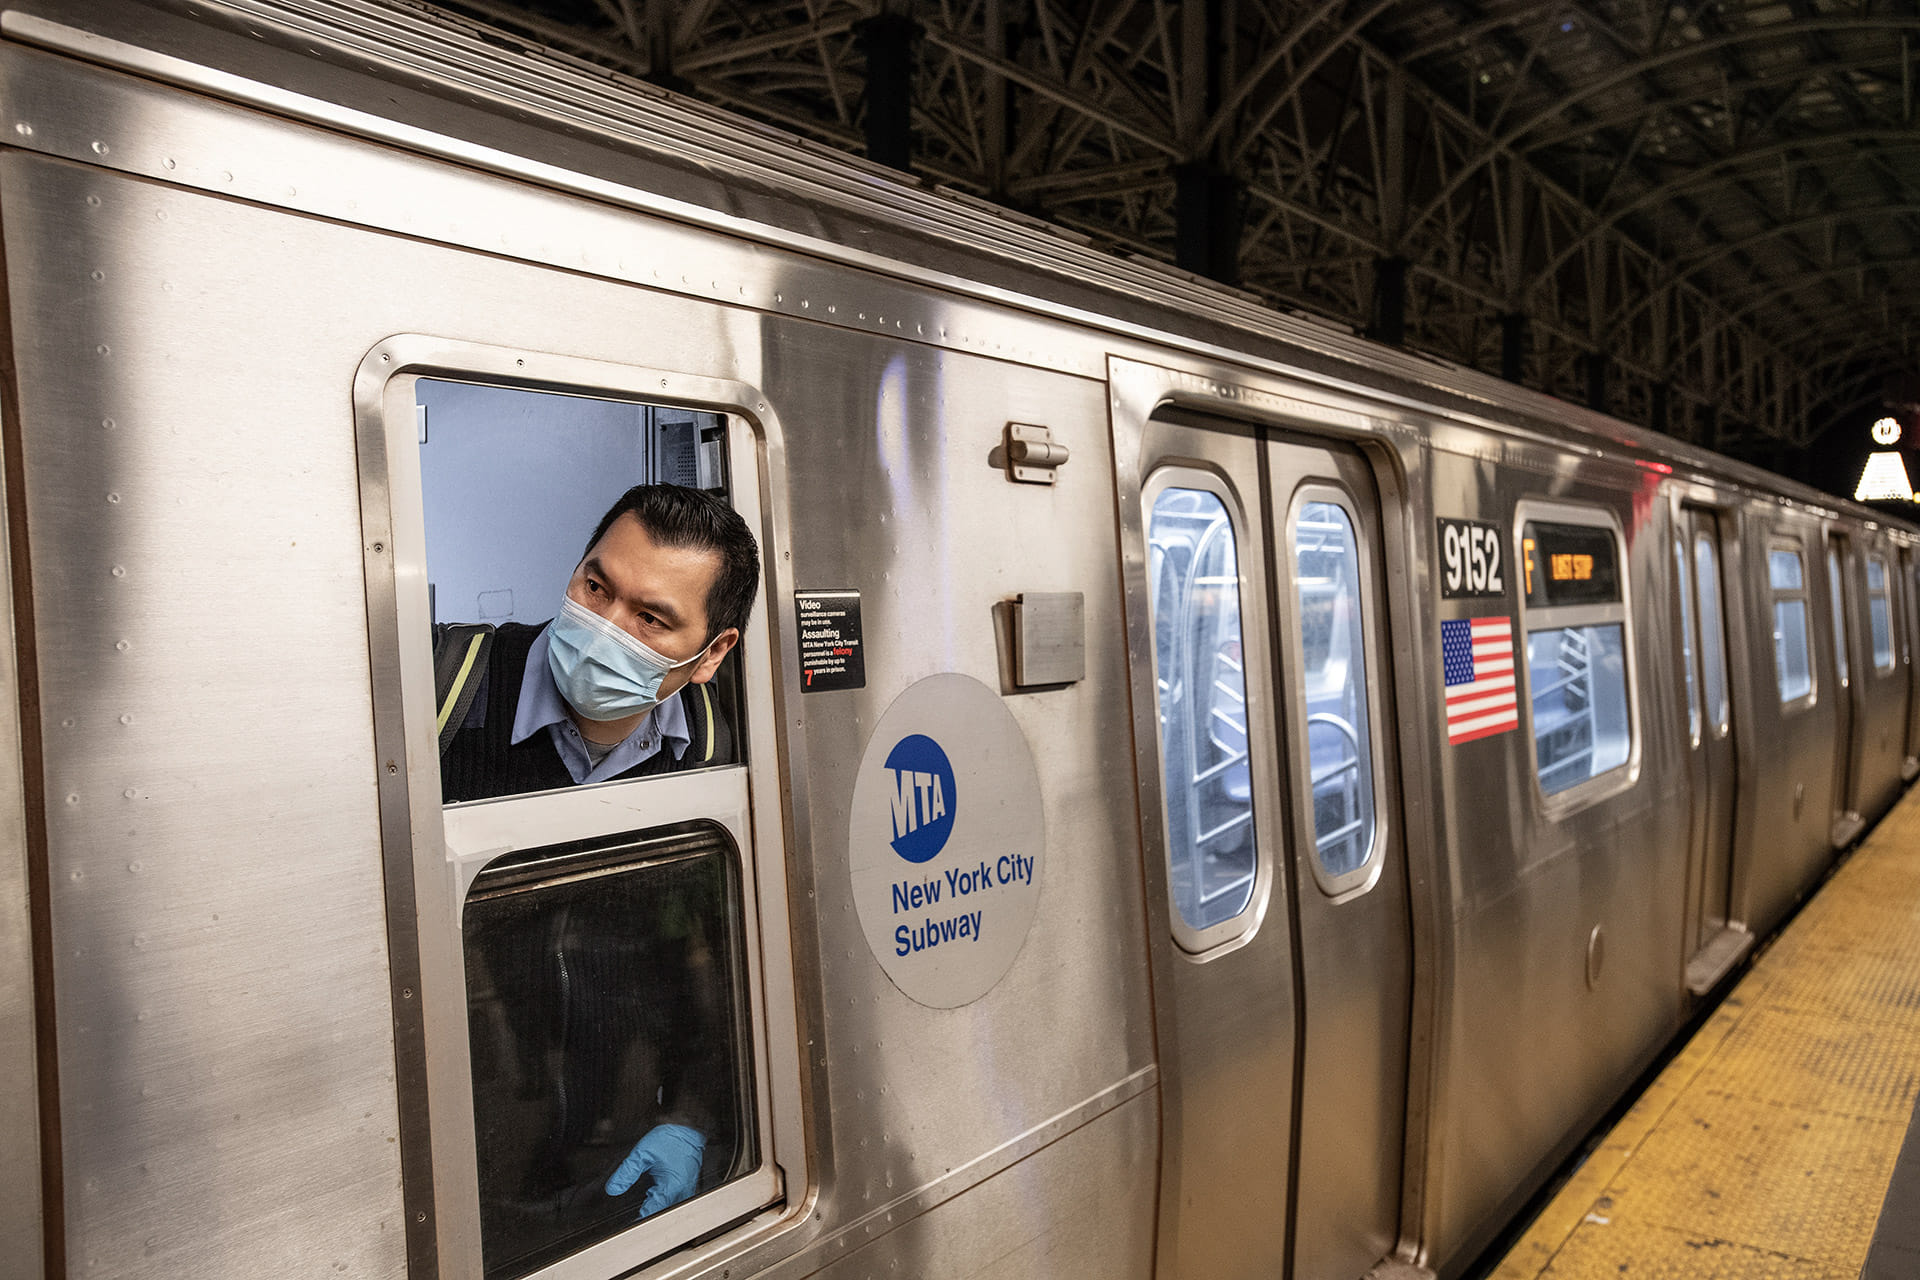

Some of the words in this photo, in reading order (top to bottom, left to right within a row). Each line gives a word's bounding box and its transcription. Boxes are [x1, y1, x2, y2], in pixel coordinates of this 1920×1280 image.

[1444, 524, 1502, 592] 9152
[1523, 538, 1535, 594] F
[800, 600, 821, 610] Video
[802, 628, 840, 639] Assaulting
[803, 650, 825, 658] personnel
[833, 647, 853, 656] felony
[804, 658, 827, 667] punishable
[804, 669, 814, 686] 7
[885, 768, 946, 840] MTA
[892, 879, 941, 914] New
[945, 862, 993, 898] York
[997, 854, 1034, 886] City
[895, 911, 982, 957] Subway
